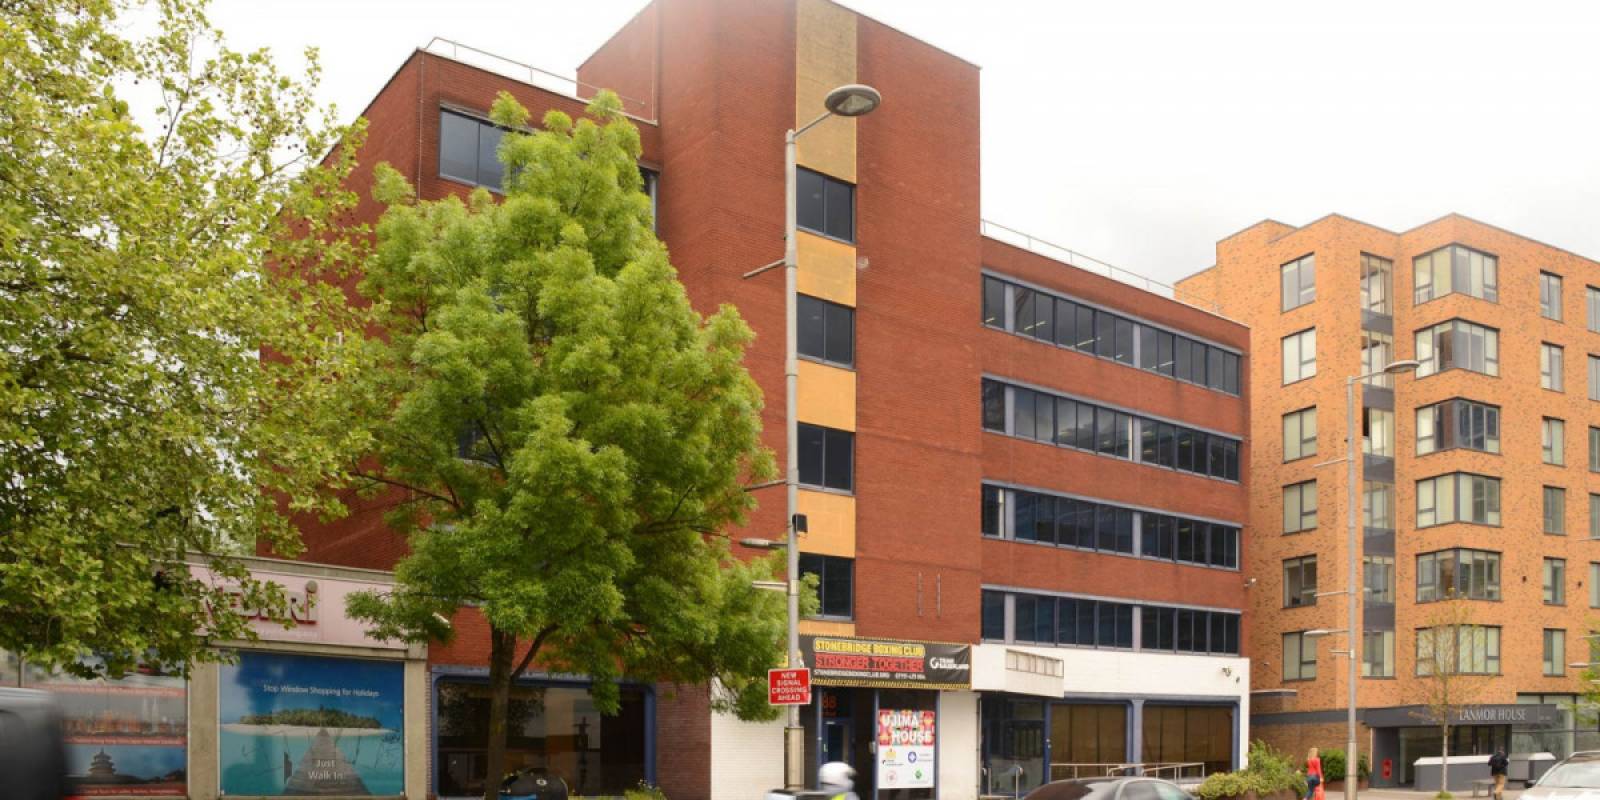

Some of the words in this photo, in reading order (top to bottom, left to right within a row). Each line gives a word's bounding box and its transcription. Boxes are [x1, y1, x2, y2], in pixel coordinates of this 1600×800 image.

[815, 640, 872, 654] STONEBRIDGE
[873, 643, 902, 656] BOXING
[903, 645, 925, 657] CLUB
[815, 654, 869, 669] STRONGER
[873, 657, 925, 672] TOGETHER
[263, 684, 279, 693] Stop
[281, 685, 308, 693] Window
[310, 686, 341, 697] Shopping
[342, 687, 352, 695] for
[354, 688, 380, 698] Holidays
[881, 714, 919, 728] UJIMA
[1459, 708, 1496, 721] LANMOR
[1498, 708, 1528, 721] HOUSE
[891, 730, 934, 744] HOUSE
[316, 759, 336, 769] Just
[308, 770, 331, 780] Walk
